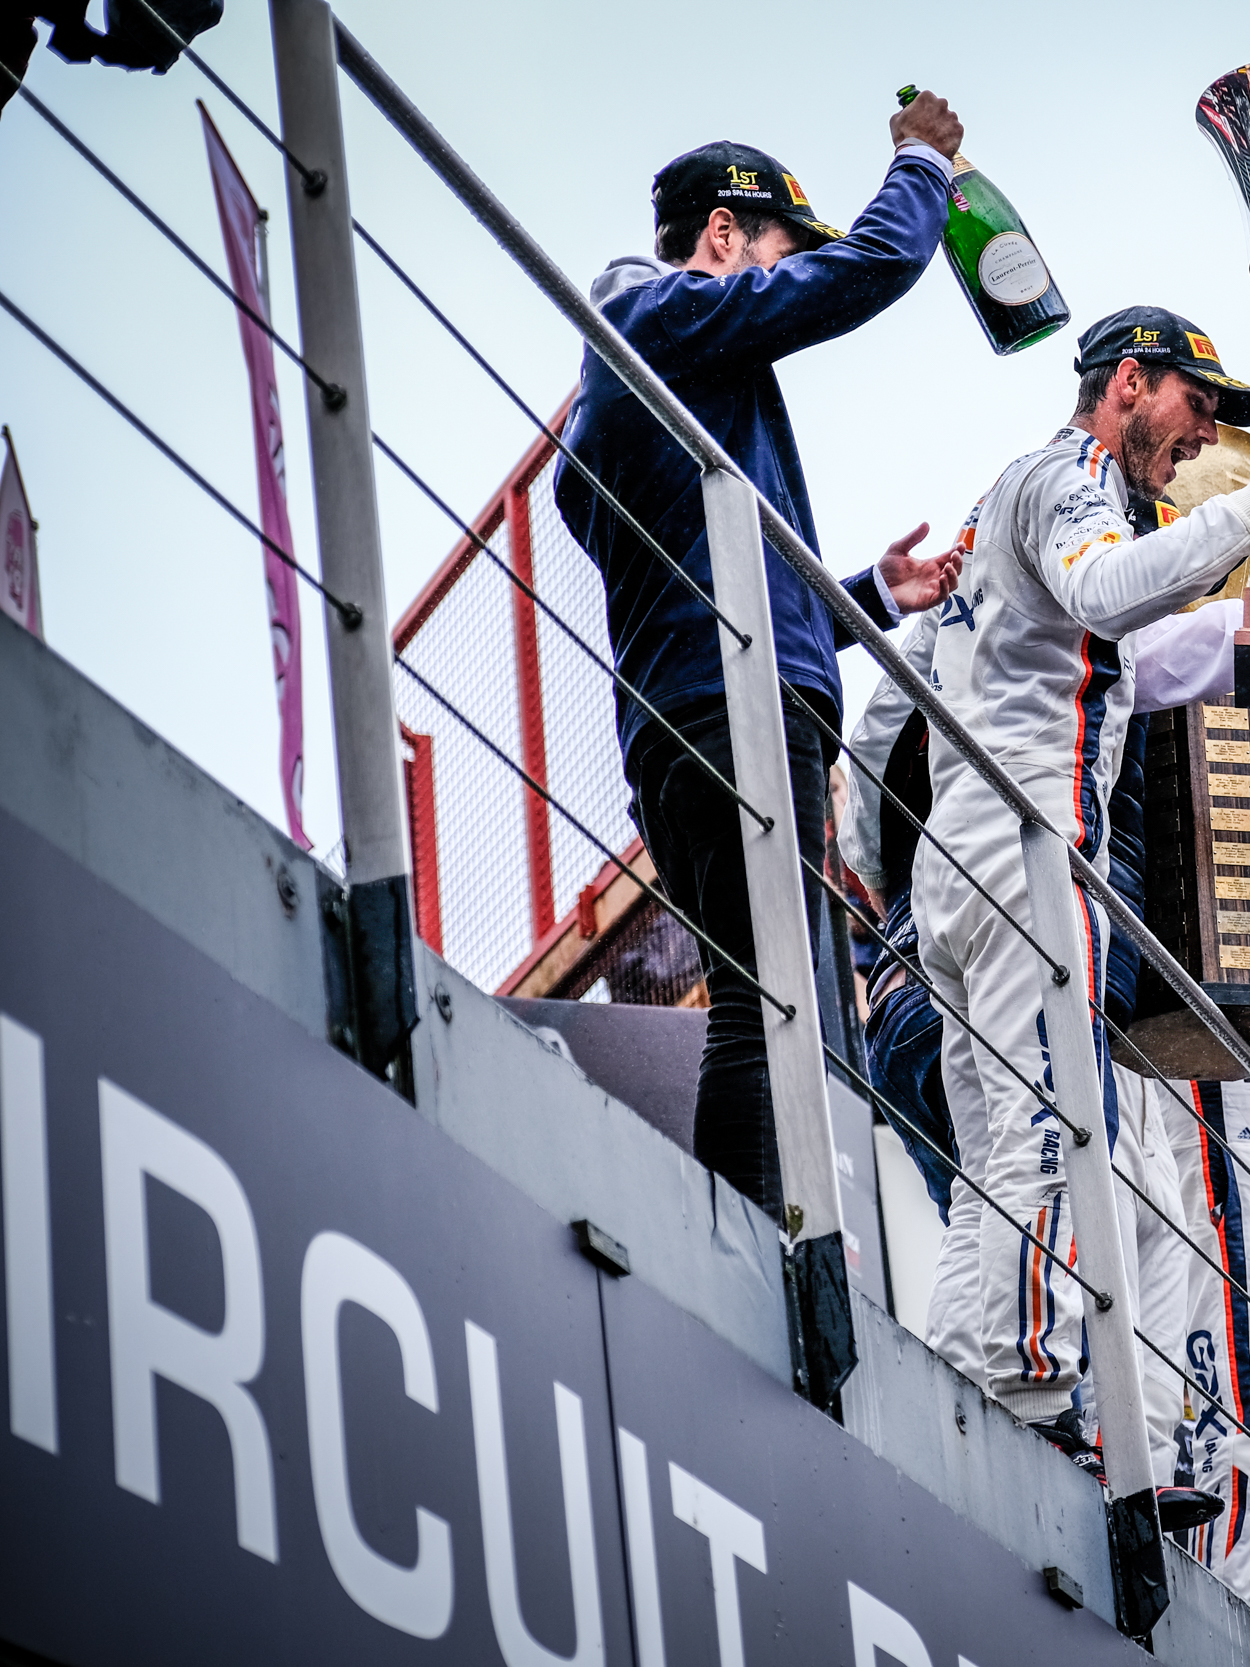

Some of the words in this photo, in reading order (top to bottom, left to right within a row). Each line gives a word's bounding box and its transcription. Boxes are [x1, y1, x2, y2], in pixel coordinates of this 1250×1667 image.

[726, 164, 758, 185] 1ST
[717, 189, 732, 197] 2019
[732, 189, 744, 197] SPA
[744, 189, 752, 198] 24
[752, 190, 772, 199] HOURS
[991, 258, 1037, 282] Laurent-Perrier
[1132, 326, 1160, 342] 1ST
[1121, 347, 1134, 355] 2019
